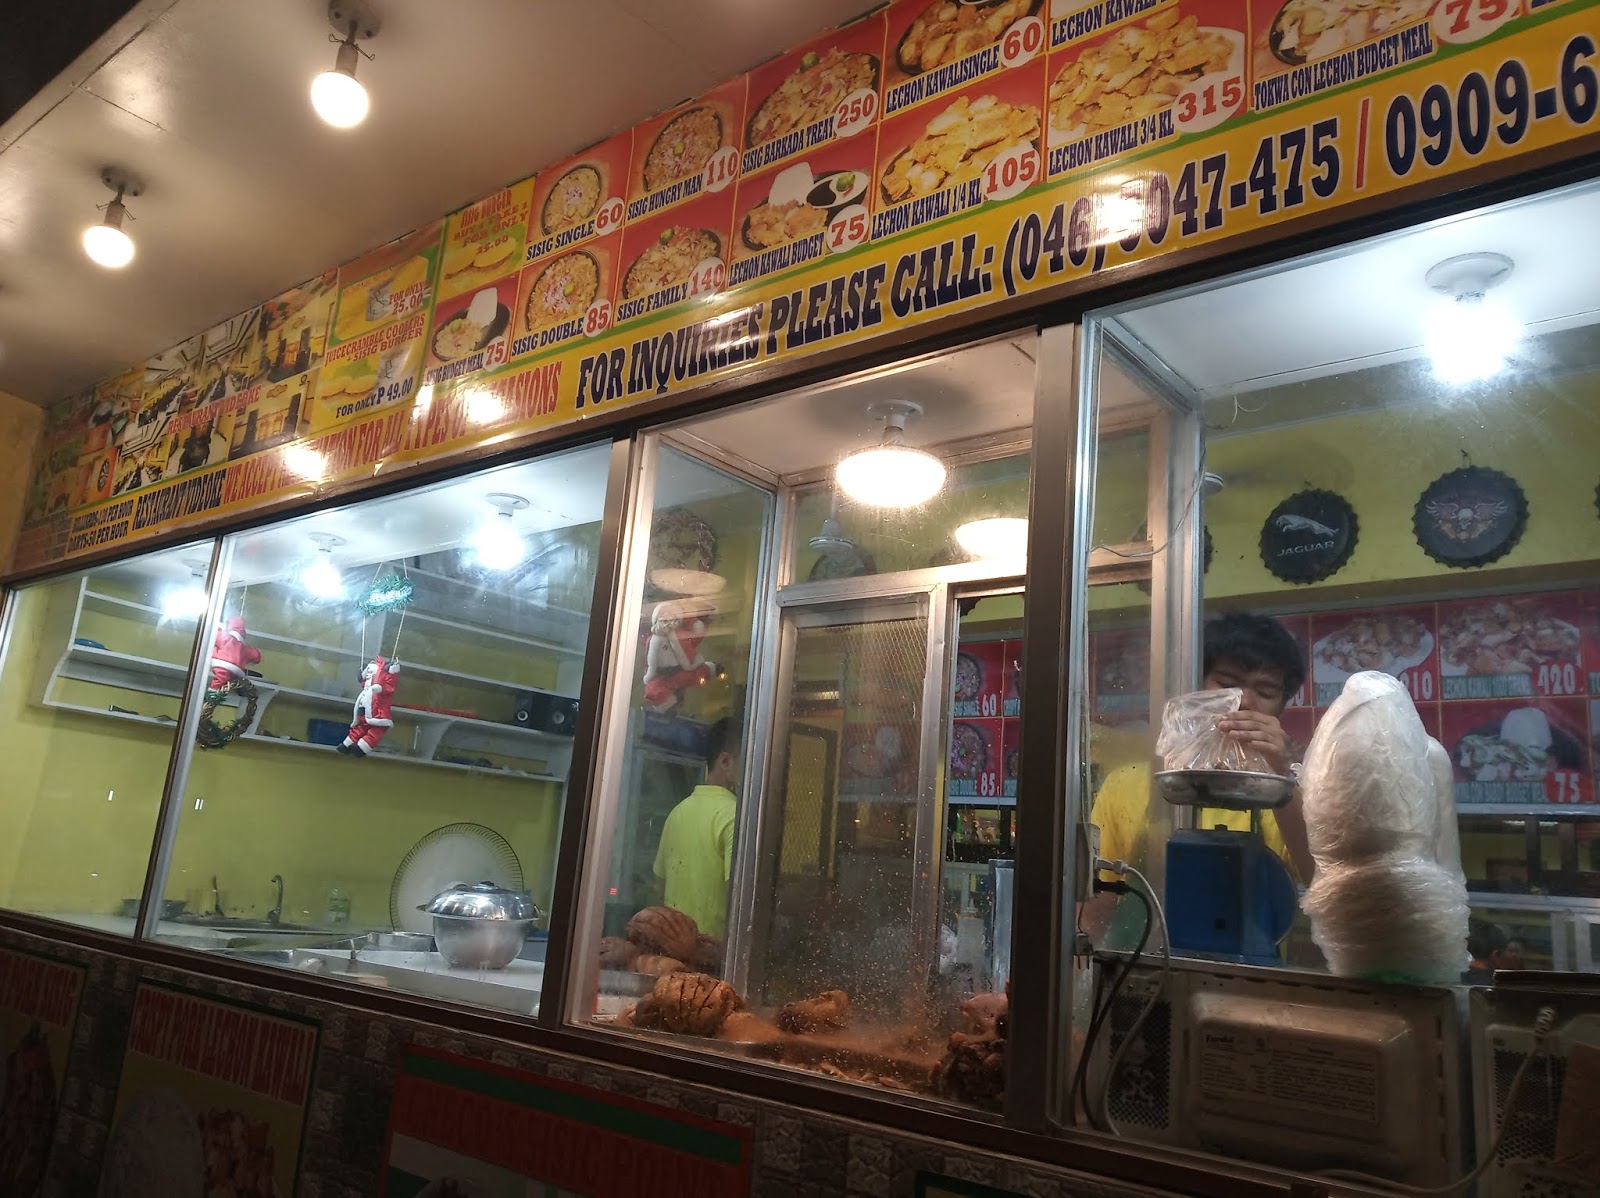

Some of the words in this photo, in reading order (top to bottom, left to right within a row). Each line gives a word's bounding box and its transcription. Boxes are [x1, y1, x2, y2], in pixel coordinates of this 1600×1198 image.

[1052, 8, 1103, 46] LECHON
[1446, 0, 1508, 35] 75
[1003, 21, 1041, 60] 60
[1254, 70, 1291, 110] TOKWA
[1291, 63, 1312, 96] CON
[1313, 46, 1355, 88] LECHON
[1357, 34, 1401, 78] BUDGET
[1402, 21, 1433, 64] MEAL
[837, 93, 874, 127] 250
[886, 80, 924, 114] LECHON
[1178, 76, 1242, 122] 315
[742, 150, 763, 172] SISIG
[764, 131, 804, 165] BARKADA
[804, 115, 834, 148] TREAT
[1049, 137, 1093, 177] LECHON
[1095, 121, 1139, 160] KAWALI
[1140, 114, 1158, 145] 3/4
[1159, 108, 1175, 139] KL
[706, 151, 738, 186] 110
[986, 150, 1036, 193] 105
[627, 200, 649, 220] SISIG
[648, 184, 683, 213] HUNGRY
[683, 172, 704, 199] MAN
[871, 204, 911, 241] LECHON
[911, 188, 951, 226] KAWALI
[952, 184, 967, 212] 1/4
[968, 177, 982, 206] KL
[596, 206, 623, 230] 60
[831, 213, 865, 248] 75
[526, 238, 553, 261] SISIG
[554, 219, 596, 250] SINGLE
[729, 254, 760, 287] LECHON
[760, 242, 791, 276] KAWALI
[790, 231, 825, 267] BUDGET
[690, 263, 724, 296] 140
[575, 347, 627, 409] FOR
[627, 302, 764, 395] INQUIRIES
[766, 263, 886, 355] PLEASE
[890, 234, 992, 318] CALL:
[586, 307, 610, 334] 85
[617, 303, 645, 323] SISIG
[646, 286, 688, 318] FAMILY
[353, 346, 378, 362] SISIG
[380, 327, 423, 352] BURGER
[485, 340, 506, 367] 75
[511, 333, 539, 357] SISIG
[540, 317, 584, 342] DOUBLE
[466, 352, 484, 373] MEAL
[335, 404, 354, 419] FOR
[354, 394, 377, 413] ONLY
[376, 386, 386, 405] P
[386, 376, 414, 402] 49.00
[354, 418, 384, 467] FOR
[1276, 540, 1335, 558] JAGUAR
[1537, 664, 1577, 696] 420
[981, 693, 998, 717] 60
[980, 771, 996, 797] 85
[1553, 773, 1580, 802] 75
